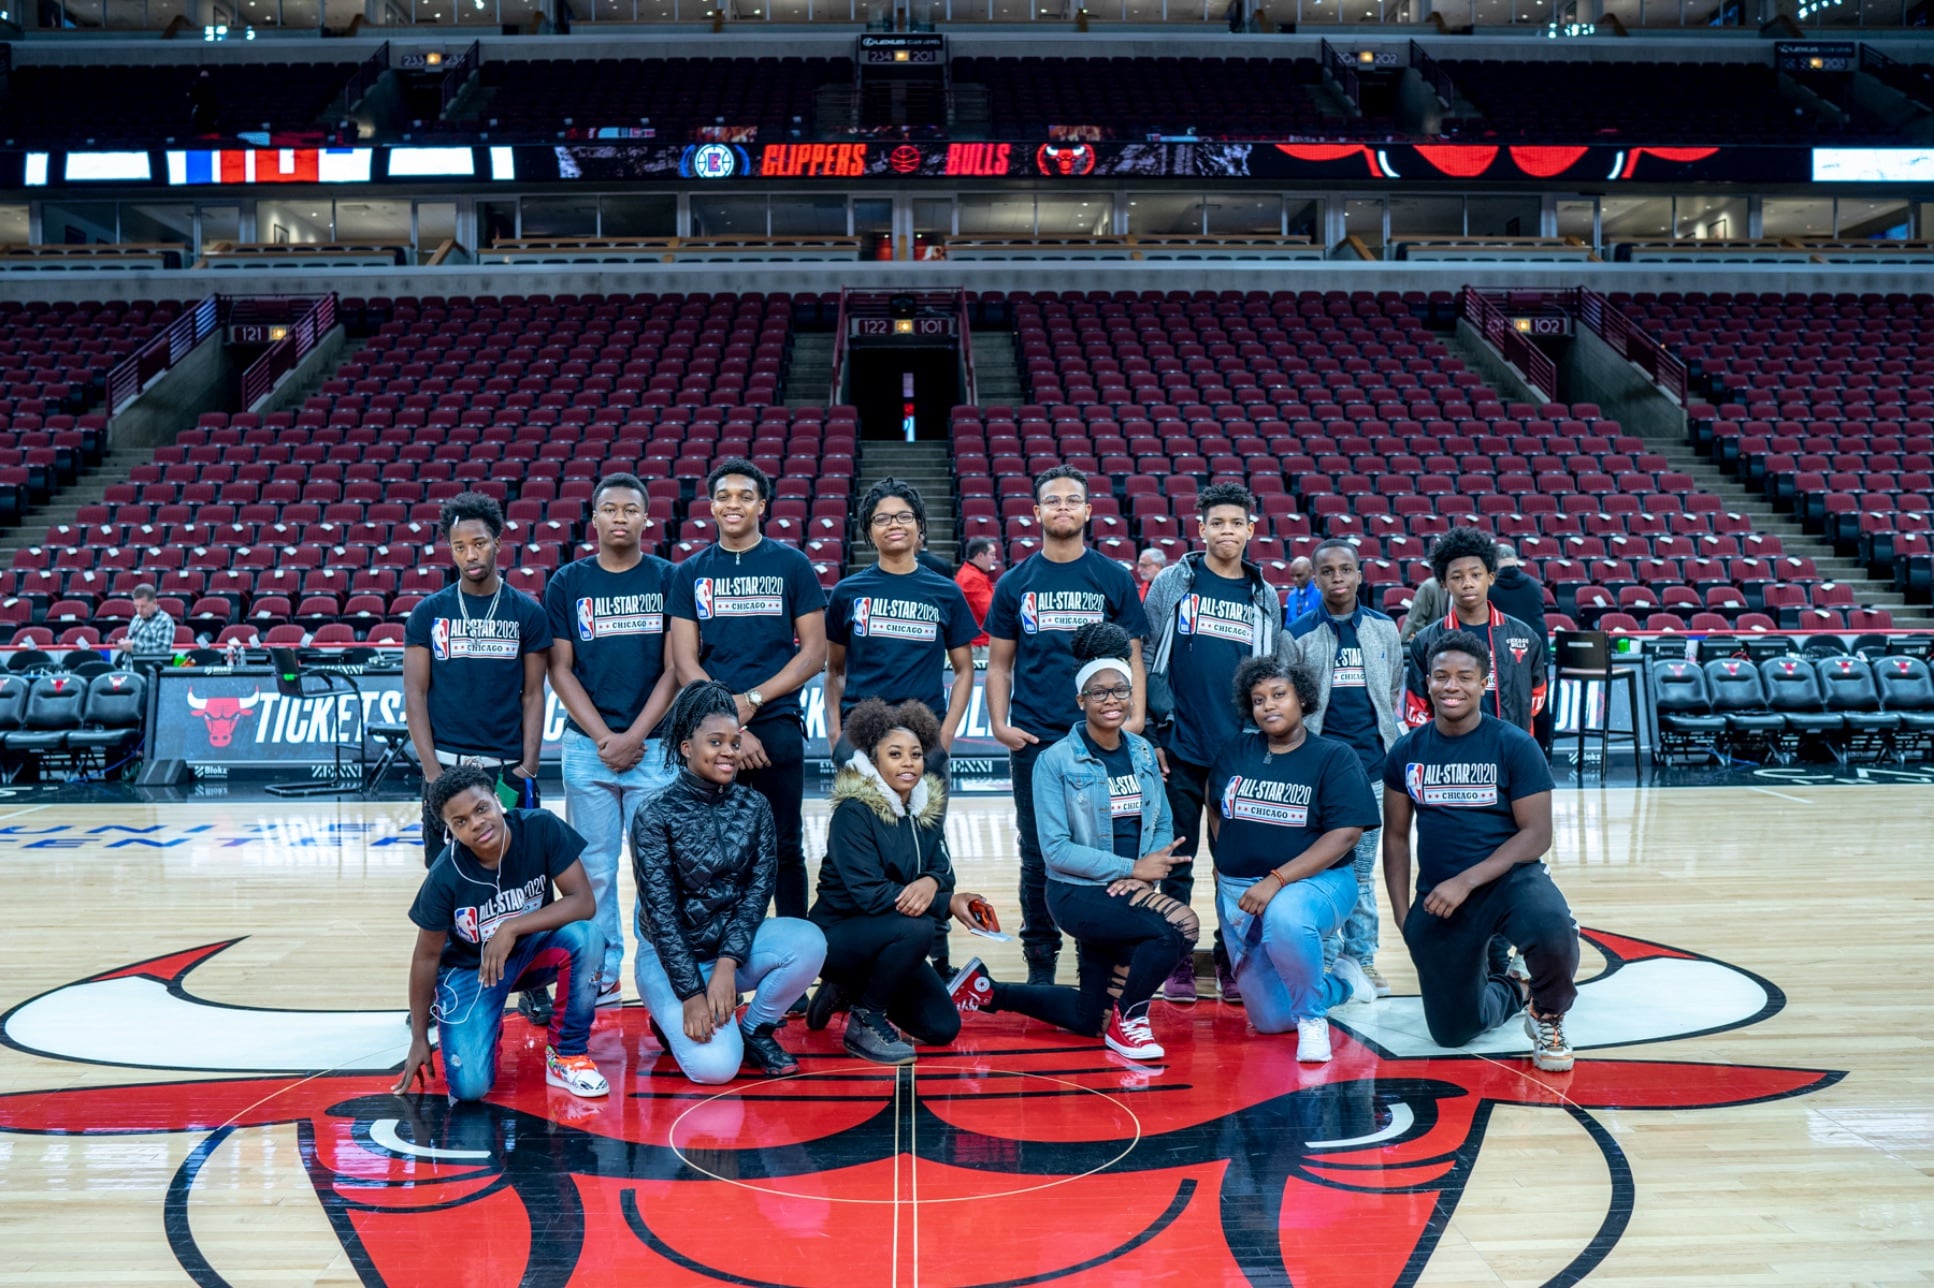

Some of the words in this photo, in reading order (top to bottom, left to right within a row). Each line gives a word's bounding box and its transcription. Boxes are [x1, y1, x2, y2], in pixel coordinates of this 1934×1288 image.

[871, 51, 892, 61] 234
[913, 51, 933, 61] 201
[1375, 54, 1397, 65] 202
[762, 144, 867, 176] CLIPPERS
[946, 143, 1011, 176] BULLS
[864, 320, 888, 334] 122
[921, 320, 942, 334] 101
[1535, 319, 1560, 333] 102
[243, 327, 261, 341] 121
[732, 602, 766, 610] CHICAGO
[612, 620, 647, 629] CHICAGO
[1054, 617, 1089, 625] CHICAGO
[886, 624, 923, 634] CHICAGO
[1214, 624, 1248, 636] CHICAGO
[466, 644, 504, 652] CHICAGO
[951, 760, 993, 773] ENNI
[1283, 783, 1313, 806] 2020
[1442, 792, 1479, 800] CHICAGO
[1250, 806, 1289, 819] CHICAGO
[0, 824, 422, 835] UNITE
[0, 836, 424, 849] ENTER
